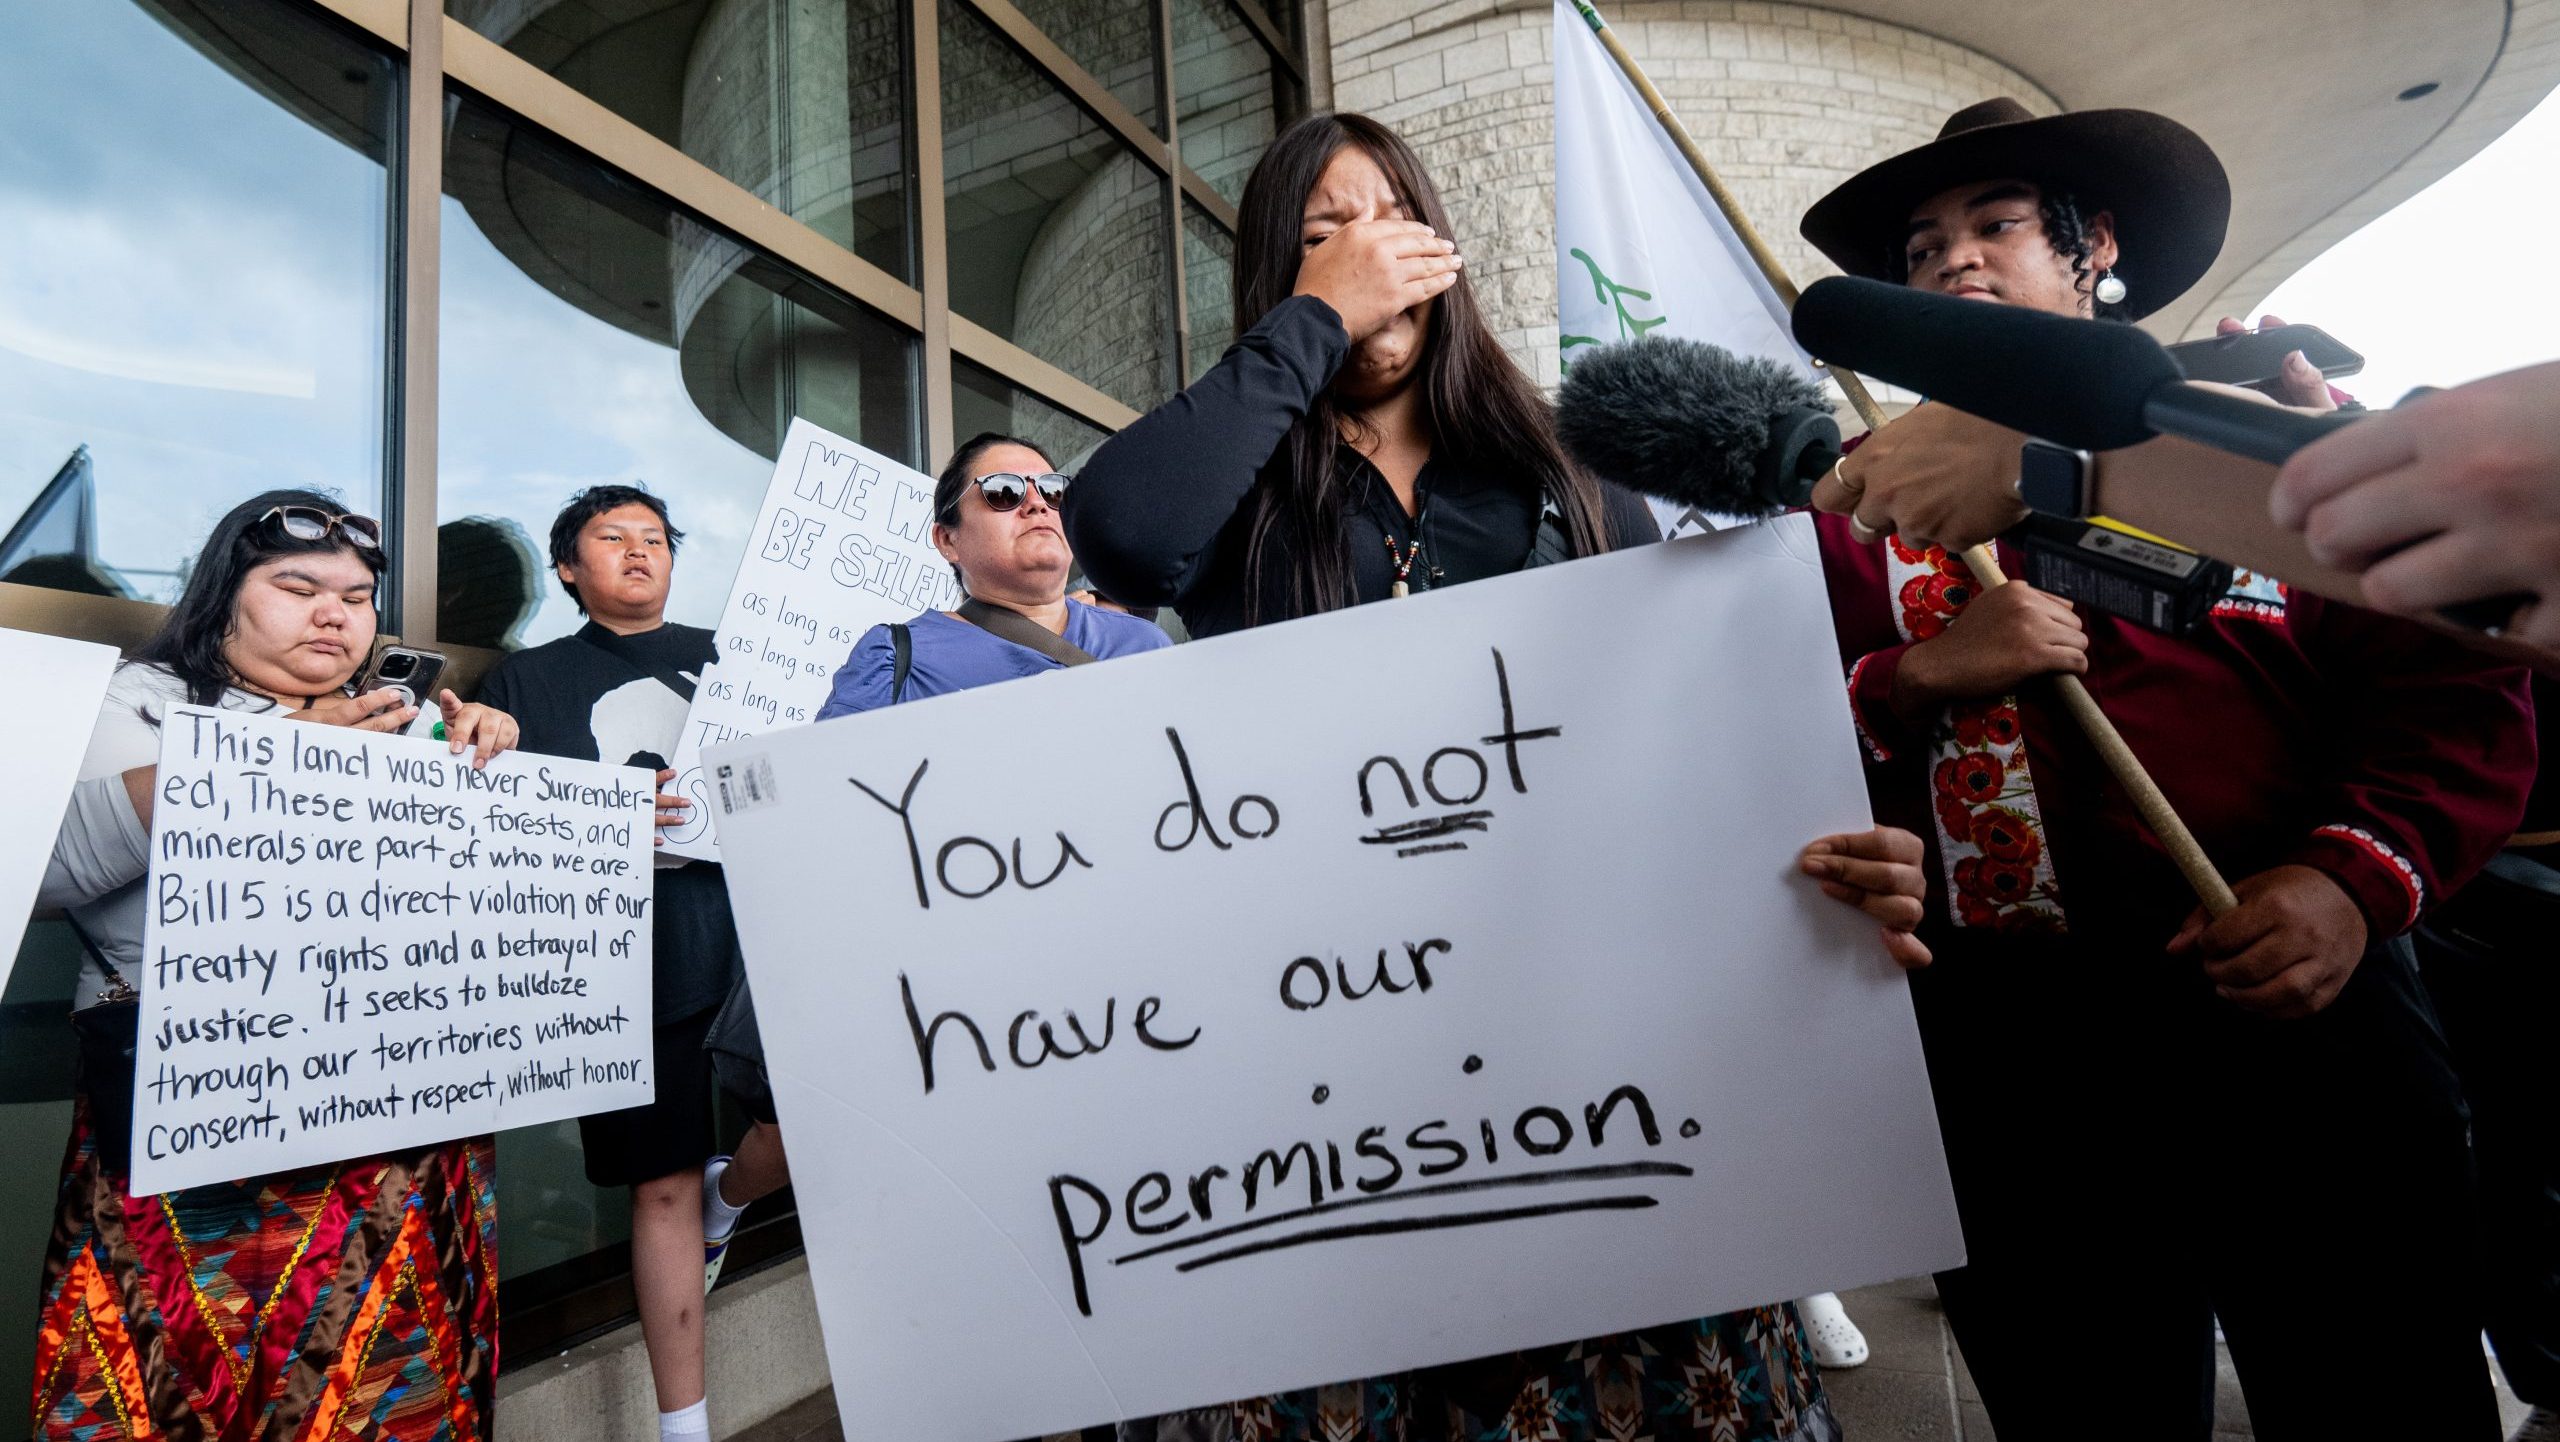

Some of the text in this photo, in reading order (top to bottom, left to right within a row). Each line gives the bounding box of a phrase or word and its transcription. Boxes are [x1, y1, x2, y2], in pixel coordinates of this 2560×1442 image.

[794, 441, 880, 521] WE
[762, 507, 962, 612] BE SILEN
[729, 636, 826, 680] as long as
[742, 592, 852, 646] as long as
[708, 681, 805, 725] as long as
[174, 711, 274, 766] This
[293, 729, 369, 779] land
[386, 755, 444, 787] was
[456, 763, 528, 797] never
[848, 646, 1562, 910] You do not
[163, 770, 630, 849] ed, These waters, forests, and
[162, 827, 639, 880] minerals are part of who we are.
[159, 873, 653, 927] Bill 5 is a direct violation of our
[154, 928, 636, 996] treaty rights and a betrayal of
[155, 970, 587, 1052] justice. It seeks to bulldoze
[898, 937, 1452, 1095] have our
[147, 1004, 629, 1105] through our territories without
[299, 1083, 405, 1131] without
[411, 1069, 504, 1114] respect,
[507, 1056, 575, 1099] without
[582, 1056, 647, 1085] honor.
[1048, 1054, 1701, 1317] permission.
